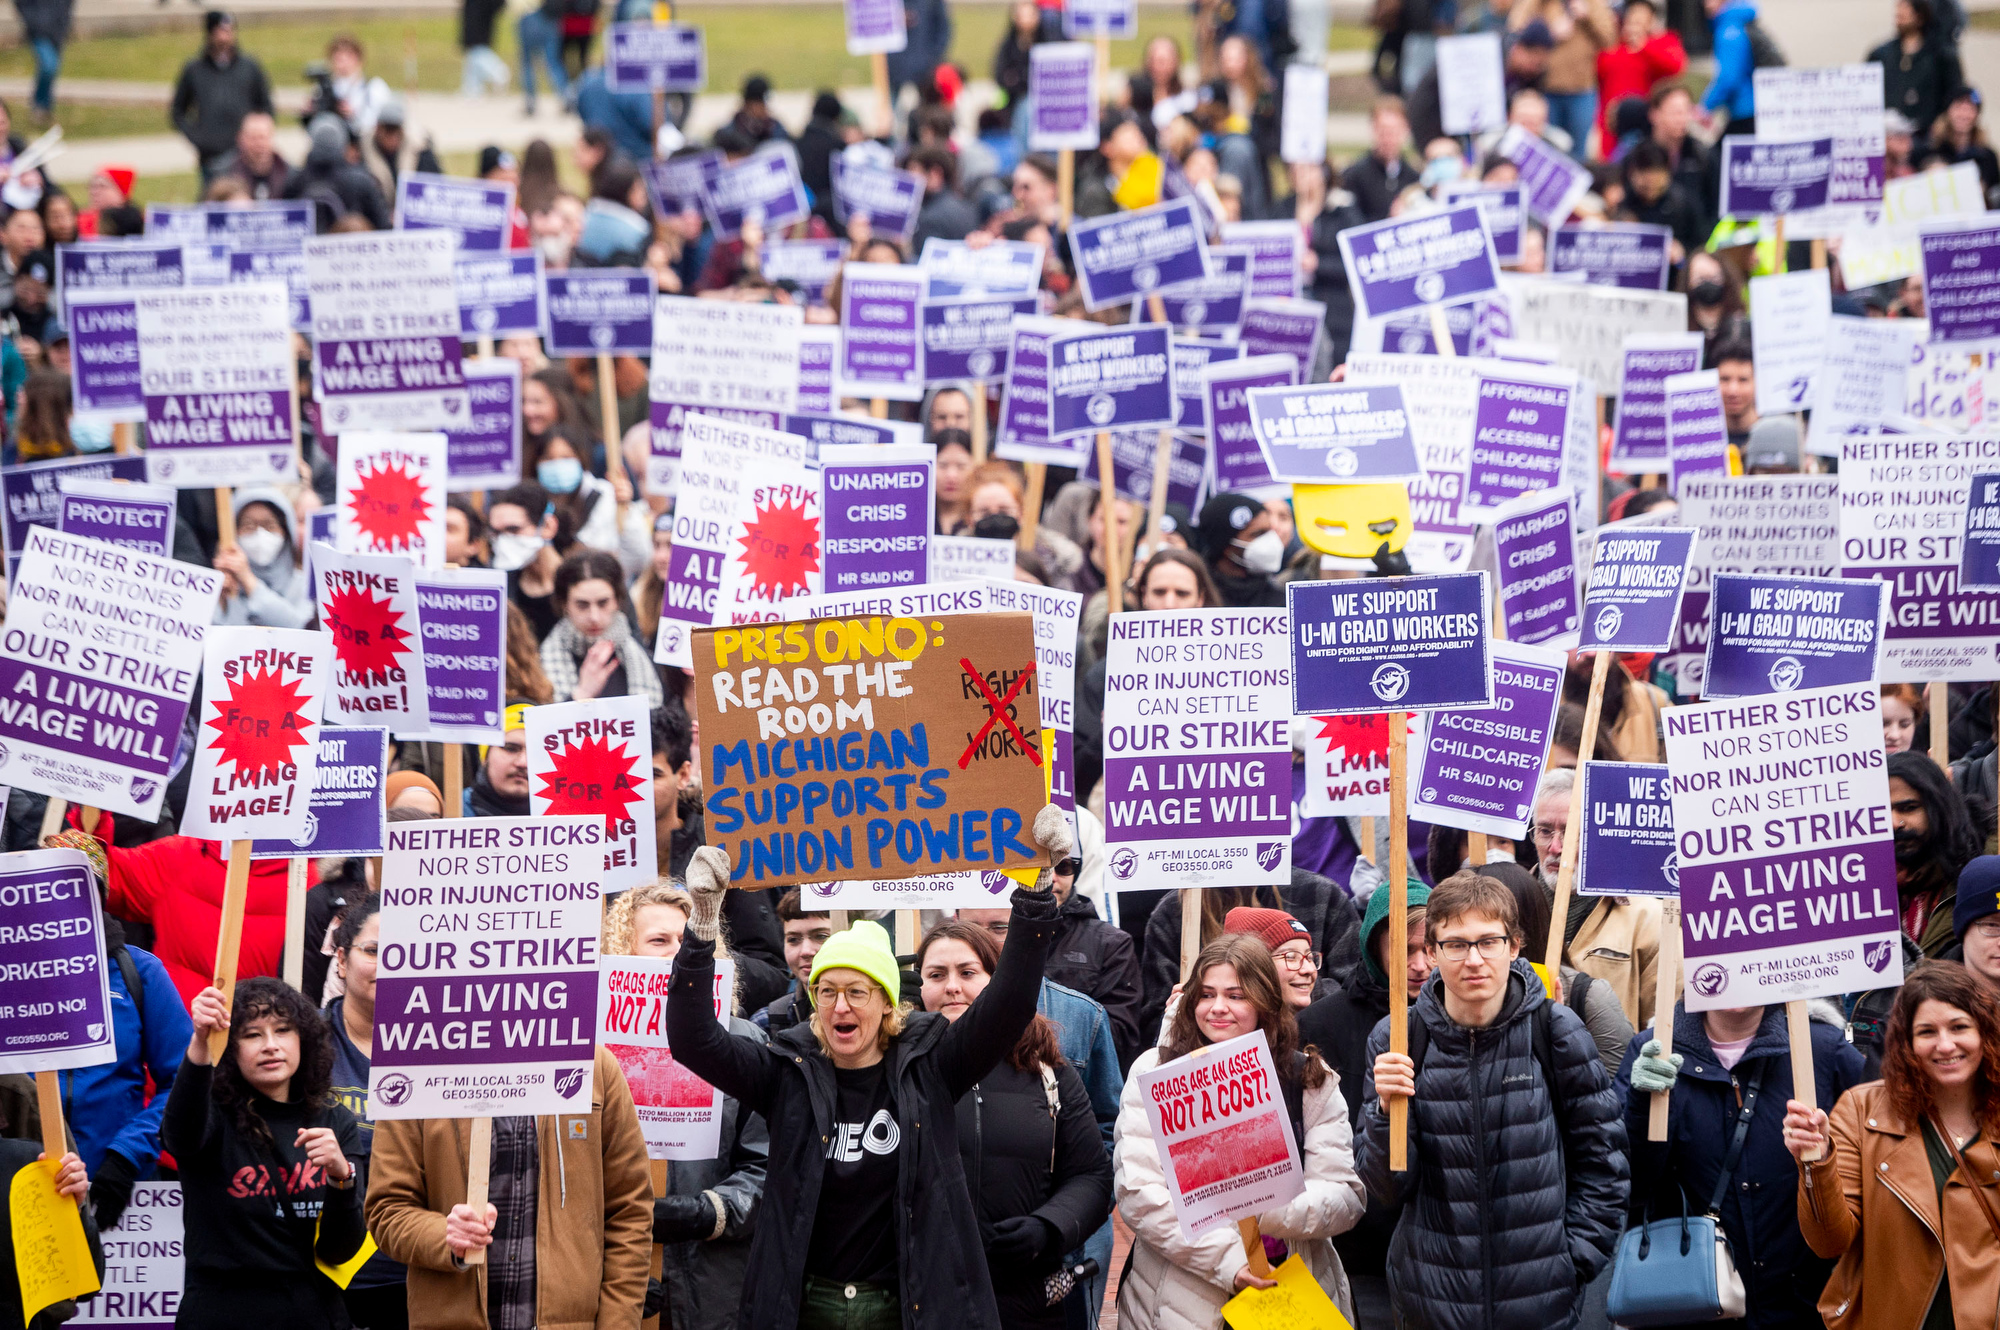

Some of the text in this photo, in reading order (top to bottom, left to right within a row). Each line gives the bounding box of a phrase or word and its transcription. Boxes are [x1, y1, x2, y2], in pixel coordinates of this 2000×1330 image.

[163, 392, 273, 419] A LIVING
[150, 416, 292, 444] WAGE WILL
[830, 472, 924, 490] UNARMED
[847, 504, 906, 522] CRISIS
[826, 536, 926, 554] RESPONSE?
[30, 534, 215, 595] NEITHER STICKS
[838, 570, 914, 585] HR SAID NO!
[51, 564, 184, 610] NOR STONES
[1332, 588, 1438, 617] WE SUPPORT
[1750, 588, 1844, 614] WE SUPPORT
[16, 582, 204, 641] NOR INJUNCTIONS
[1721, 612, 1874, 642] U-M GRAD WORKERS
[42, 611, 168, 657] CAN SETTLE
[714, 617, 945, 668] PRES ONO:
[1112, 616, 1287, 640] NEITHER STICKS
[1301, 613, 1478, 646] U-M GRAD WORKERS
[5, 630, 192, 696] OUR STRIKE
[223, 648, 313, 678] STRIKE
[1136, 643, 1263, 663] NOR STONES
[1307, 640, 1474, 657] UNITED FOR DIGNITY AND AFFORDABILITY
[712, 661, 913, 713] READ THE
[1108, 669, 1289, 691] NOR INJUNCTIONS
[13, 670, 159, 727] A LIVING
[1138, 695, 1258, 716] CAN SETTLE
[1668, 690, 1876, 736] NEITHER STICKS
[0, 698, 169, 763] WAGE WILL
[226, 708, 296, 738] FOR A
[757, 698, 874, 740] ROOM
[1438, 713, 1542, 744] ACCESSIBLE
[966, 728, 1039, 761] WORK
[1108, 720, 1288, 751] OUR STRIKE
[1703, 724, 1849, 760] NOR STONES
[712, 723, 930, 786] MICHIGAN
[1430, 738, 1541, 770] CHILDCARE?
[212, 763, 297, 795] LIVING
[1128, 761, 1265, 792] A LIVING
[1438, 766, 1523, 792] HR SAID NO!
[1672, 749, 1883, 793] NOR INJUNCTIONS
[209, 784, 294, 823] WAGE!
[706, 768, 950, 833] SUPPORTS
[1109, 795, 1287, 827] WAGE WILL
[1712, 781, 1850, 816] CAN SETTLE
[389, 824, 600, 851] NEITHER STICKS
[720, 808, 1037, 881] UNION POWER
[1680, 805, 1888, 859] OUR STRIKE
[419, 854, 568, 876] NOR STONES
[1148, 848, 1248, 861] AFT-MI LOCAL 3550
[1162, 861, 1233, 872] GEO3550.ORG
[0, 878, 84, 907] OTECT
[1709, 853, 1867, 902] A LIVING
[384, 882, 600, 906] NOR INJUNCTIONS
[0, 917, 92, 944] RASSED
[420, 910, 562, 932] CAN SETTLE
[1686, 888, 1894, 942] WAGE WILL
[382, 937, 596, 971] OUR STRIKE
[1740, 950, 1855, 975] AFT-MI LOCAL 3550
[1759, 965, 1839, 986] GEO3550.ORG
[18, 1002, 54, 1018] SAID
[58, 998, 86, 1014] NO!
[404, 981, 568, 1014] A LIVING
[379, 1017, 590, 1051] WAGE WILL
[425, 1074, 545, 1087] AFT-MI LOCAL 3550
[1151, 1047, 1261, 1103] GRADS ARE AN ASSET
[442, 1088, 526, 1100] GEO3550.ORG
[1158, 1068, 1271, 1136] NOT A COST!
